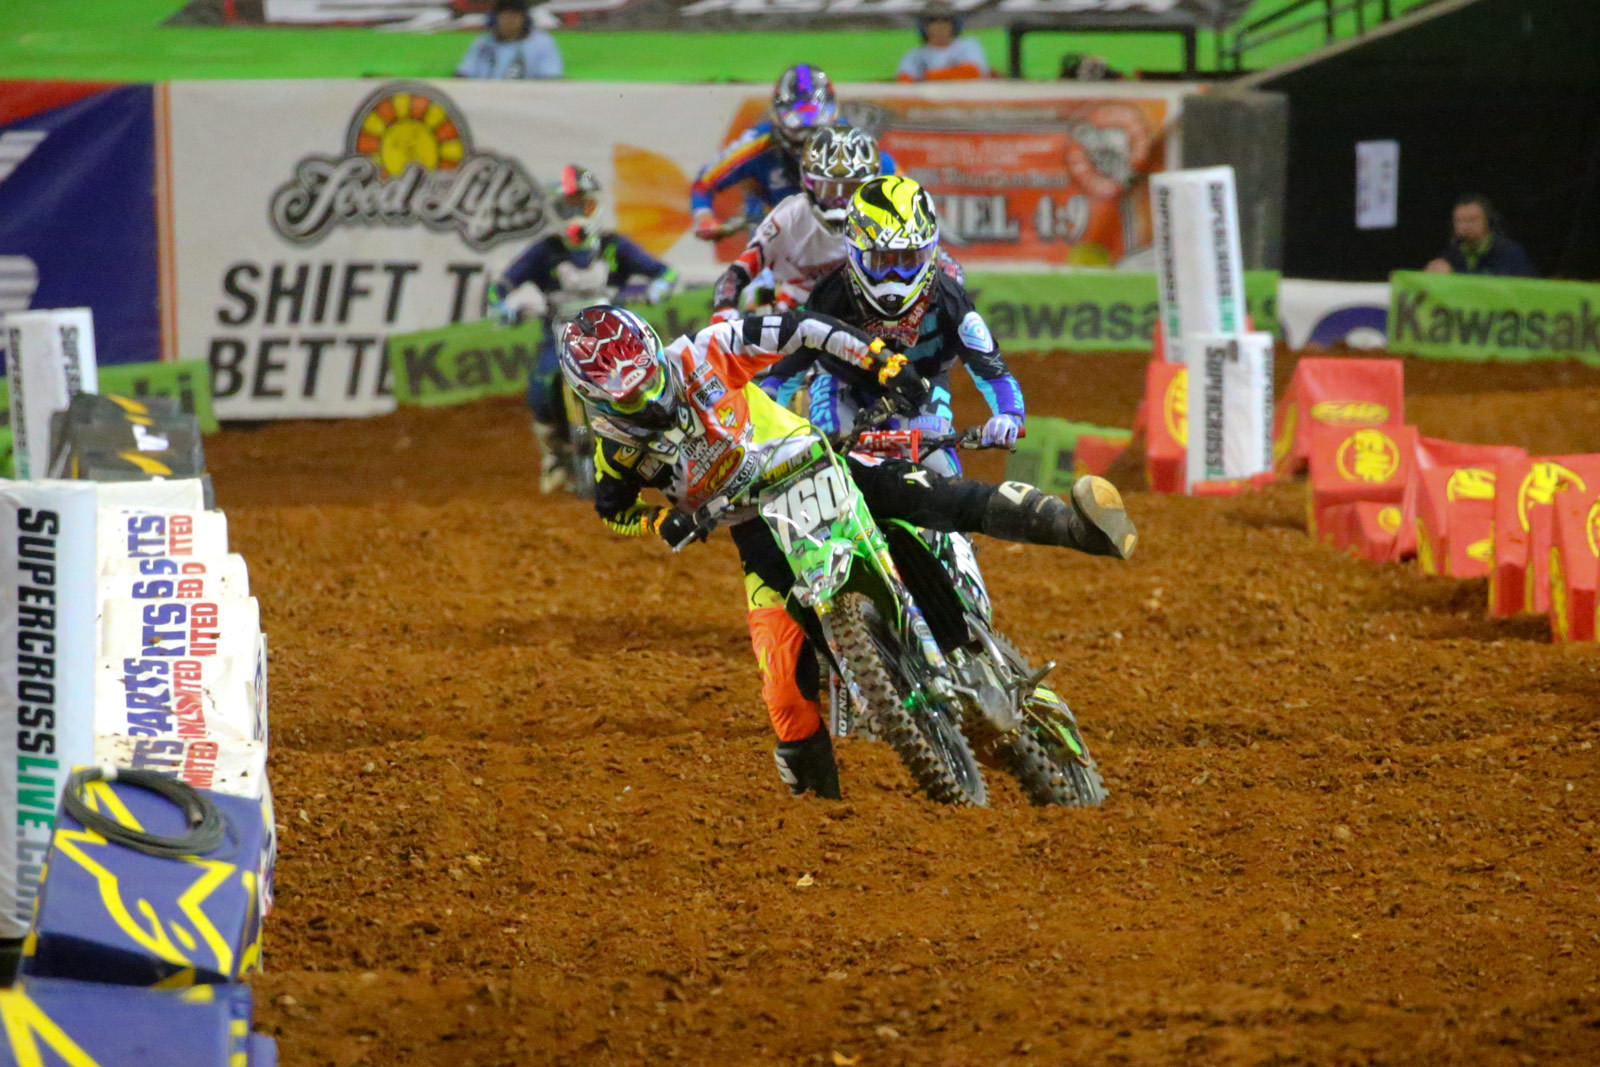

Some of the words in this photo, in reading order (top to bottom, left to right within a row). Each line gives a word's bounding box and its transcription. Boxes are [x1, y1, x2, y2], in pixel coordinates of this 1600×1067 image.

[216, 262, 420, 326] SHIFT
[1395, 291, 1600, 352] Kawasak
[403, 341, 538, 397] Kaw
[1204, 346, 1226, 479] SUPERCROSSL
